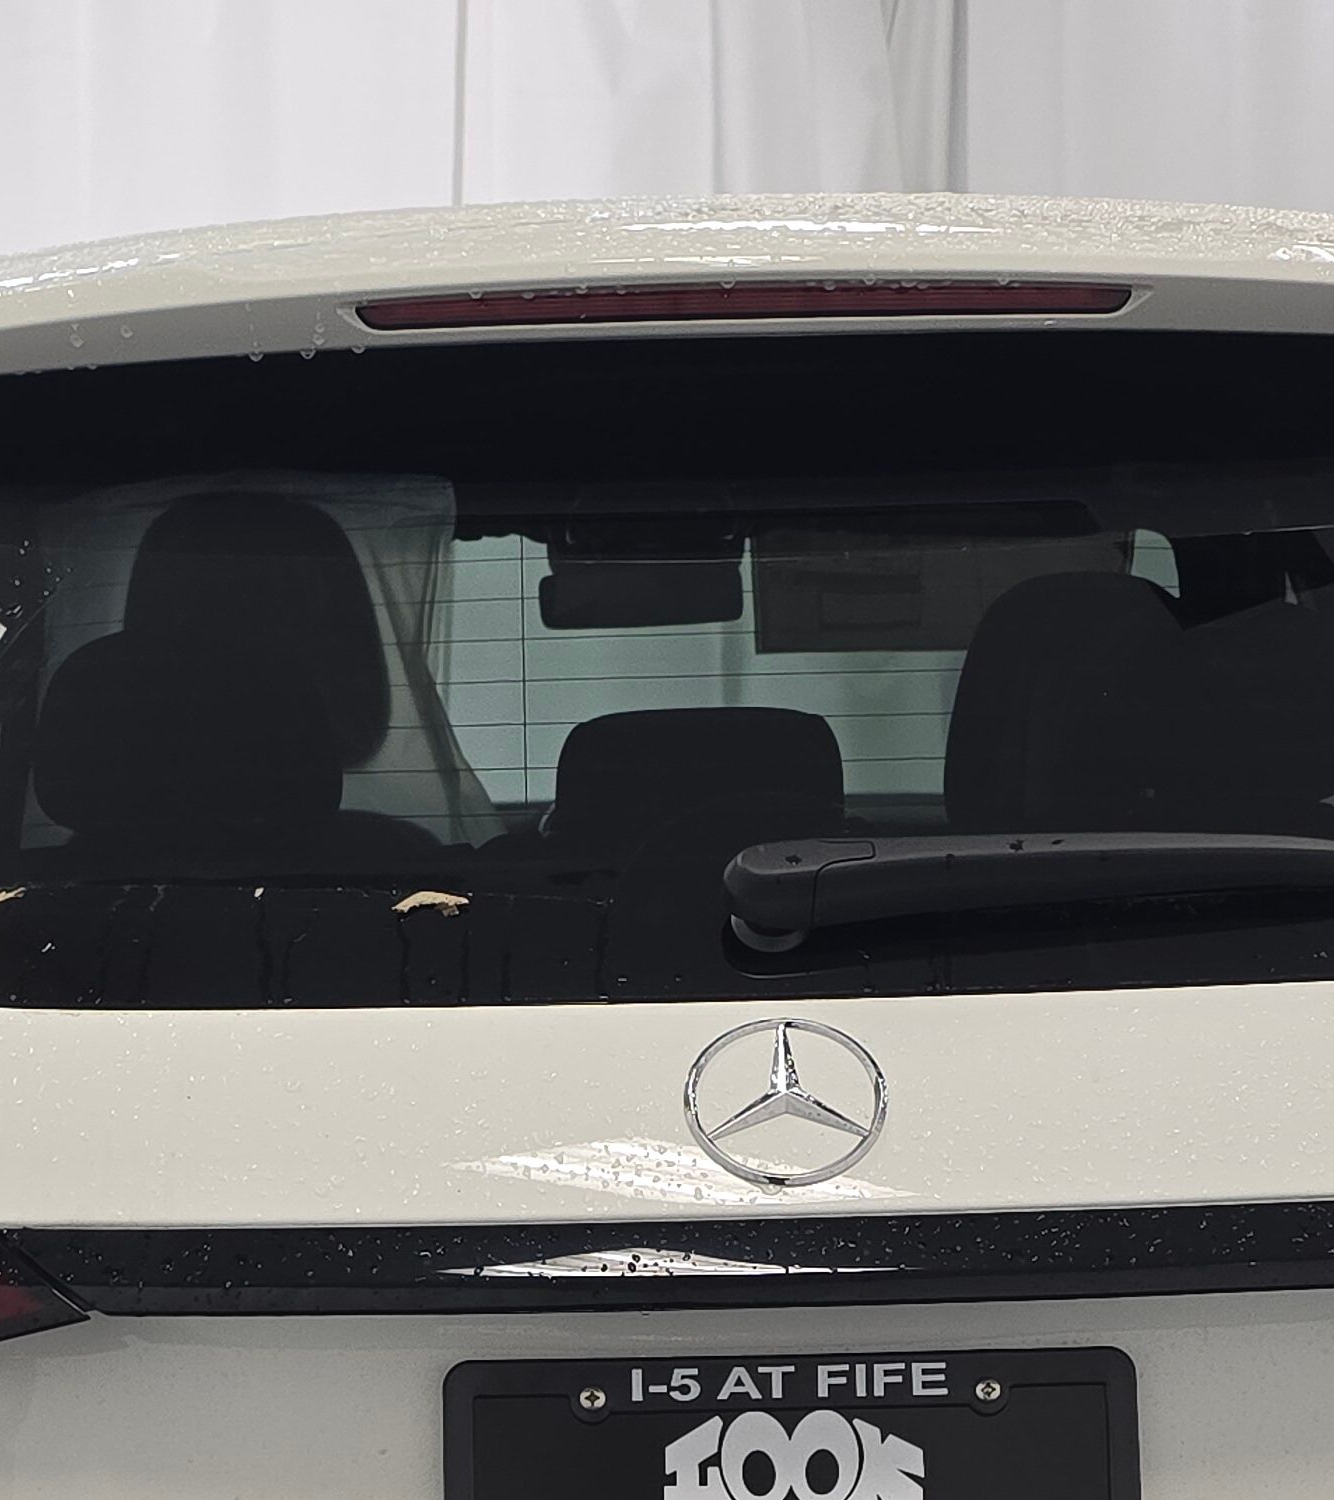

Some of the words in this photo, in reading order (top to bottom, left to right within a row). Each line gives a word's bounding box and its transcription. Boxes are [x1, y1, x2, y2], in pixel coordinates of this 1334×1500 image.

[631, 1368, 701, 1402] I-5
[717, 1365, 796, 1400] AT
[817, 1362, 949, 1398] FIFE
